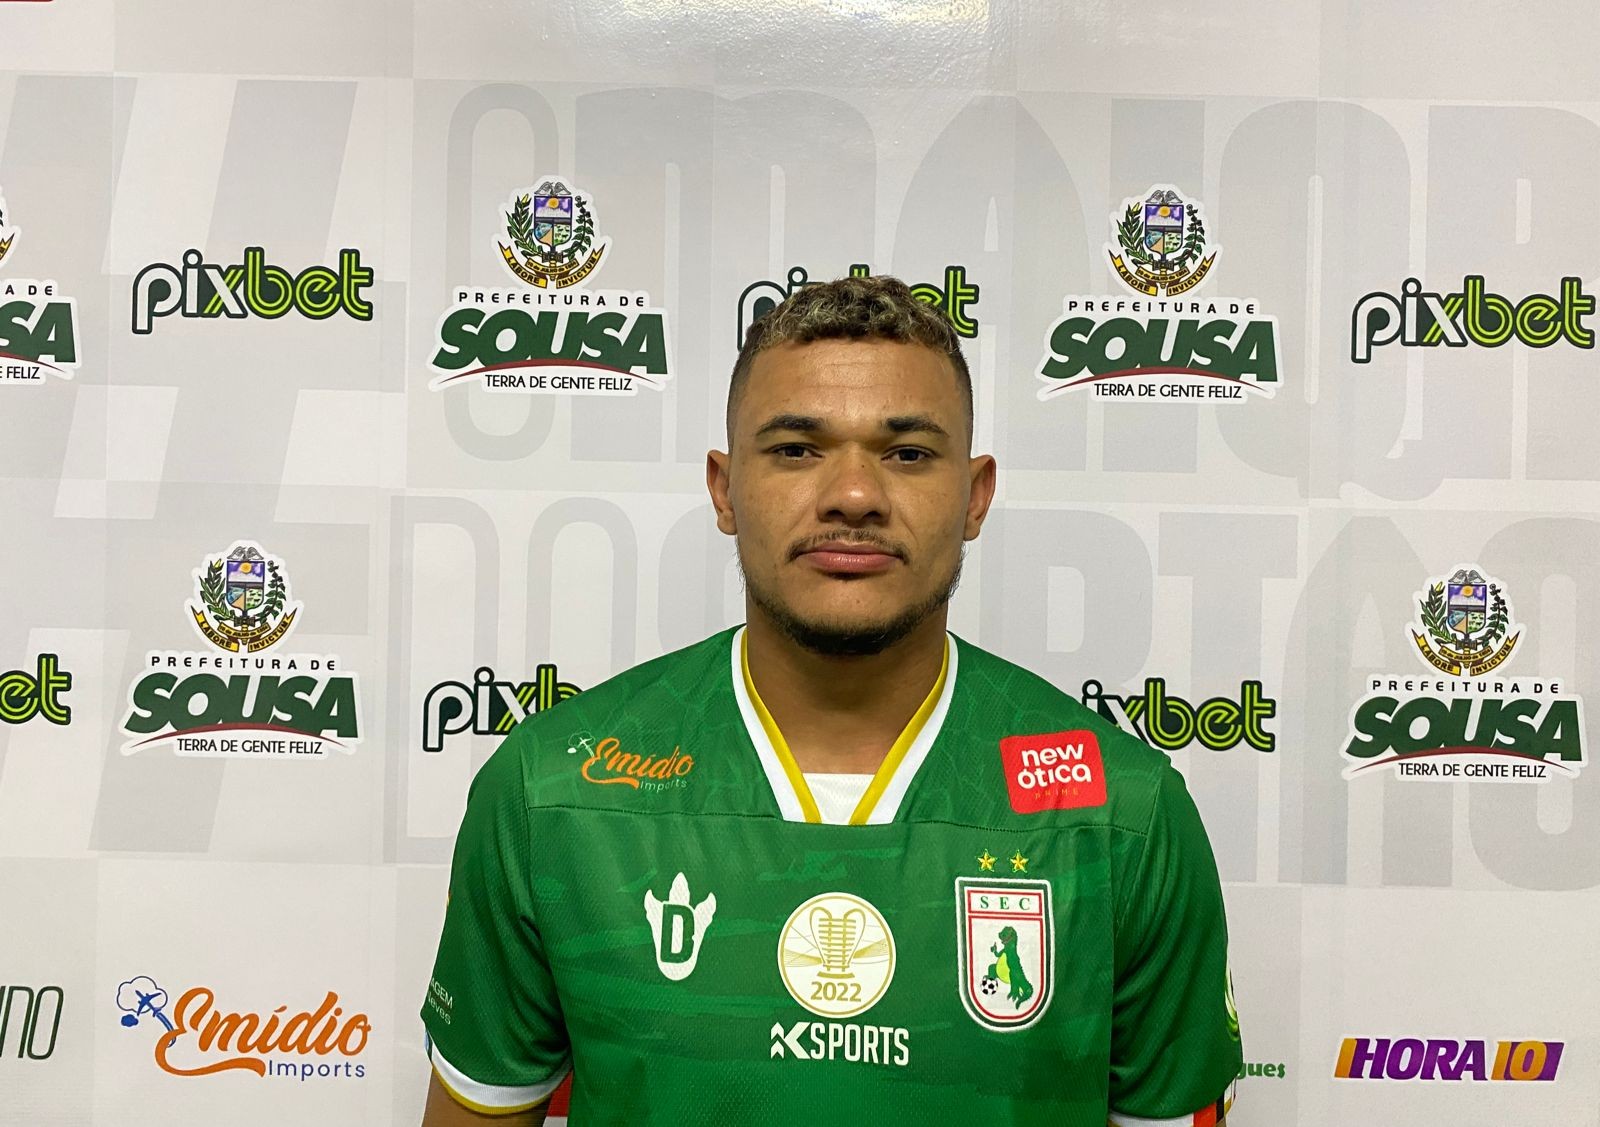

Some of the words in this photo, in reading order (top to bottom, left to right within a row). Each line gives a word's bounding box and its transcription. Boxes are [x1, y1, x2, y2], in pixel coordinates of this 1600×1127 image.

[507, 256, 540, 285] LABORE
[558, 257, 597, 287] INVICTUM
[1117, 264, 1150, 292] LABORE
[1169, 265, 1208, 294] INVICTUM
[28, 285, 52, 296] DE
[132, 247, 374, 334] pixbet
[459, 292, 606, 306] PREFEITURA
[620, 296, 644, 307] DE
[1068, 301, 1216, 314] PREFEITURA
[1230, 303, 1255, 314] DE
[1351, 275, 1595, 363] pixbet
[432, 308, 668, 374] SOUSA
[1041, 316, 1278, 382] SOUSA
[6, 366, 40, 379] FELIZ
[485, 374, 526, 388] TERRA
[530, 376, 546, 389] DE
[550, 376, 595, 390] GENTE
[599, 378, 632, 390] FELIZ
[1094, 383, 1134, 396] TERRA
[1138, 384, 1155, 396] DE
[1160, 384, 1204, 398] GENTE
[1208, 386, 1242, 398] FELIZ
[200, 621, 232, 648] LABORE
[250, 622, 288, 650] INVICTUM
[151, 656, 297, 670] PREFEITURA
[311, 660, 335, 671] DE
[1420, 645, 1454, 672] LABORE
[1472, 644, 1510, 674] INVICTUM
[1372, 680, 1520, 693] PREFEITURA
[1534, 683, 1559, 694] DE
[124, 672, 358, 738] SOUSA
[1346, 696, 1582, 762] SOUSA
[177, 738, 217, 751] TERRA
[221, 739, 238, 752] DE
[242, 740, 286, 753] GENTE
[289, 741, 322, 754] FELIZ
[1022, 744, 1084, 767] new
[1018, 763, 1092, 789] ótica
[1399, 763, 1439, 776] TERRA
[1443, 764, 1460, 776] DE
[1464, 764, 1508, 777] GENTE
[1512, 765, 1546, 778] FELIZ
[660, 904, 695, 964] D
[810, 981, 862, 1002] 2022
[155, 987, 372, 1078] Emídio
[268, 1060, 365, 1081] Imports
[1348, 1038, 1488, 1081] HORA
